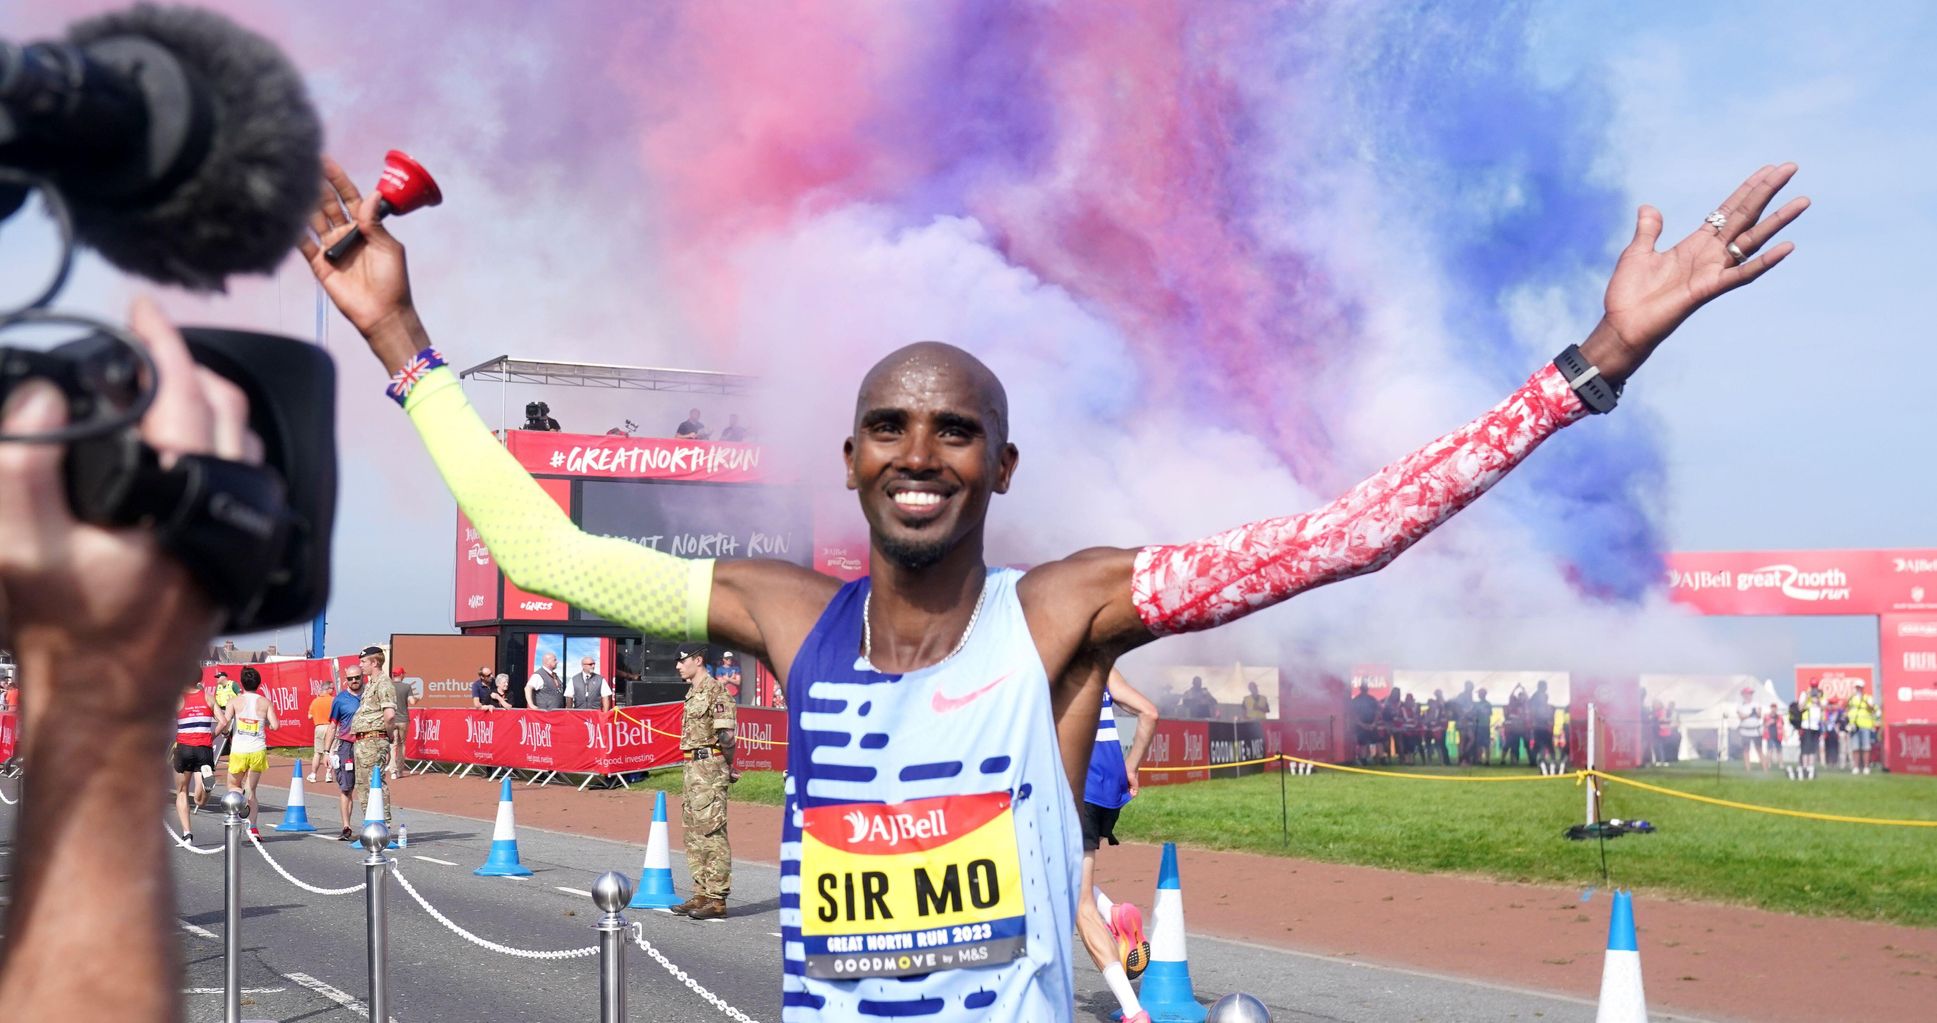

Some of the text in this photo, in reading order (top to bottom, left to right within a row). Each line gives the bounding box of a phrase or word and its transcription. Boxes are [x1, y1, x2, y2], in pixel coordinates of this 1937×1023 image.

[550, 445, 760, 473] #GREATNORTHRUN
[670, 532, 740, 557] NORTH
[747, 531, 792, 556] RUN
[1737, 572, 1782, 591] great
[1798, 568, 1847, 587] north
[428, 679, 472, 691] enthus
[868, 808, 949, 846] AJBell
[817, 859, 1001, 922] SIR MO
[827, 923, 992, 952] GREAT NORTH RUN 2023
[834, 946, 989, 973] GOODMOVE by M&S
